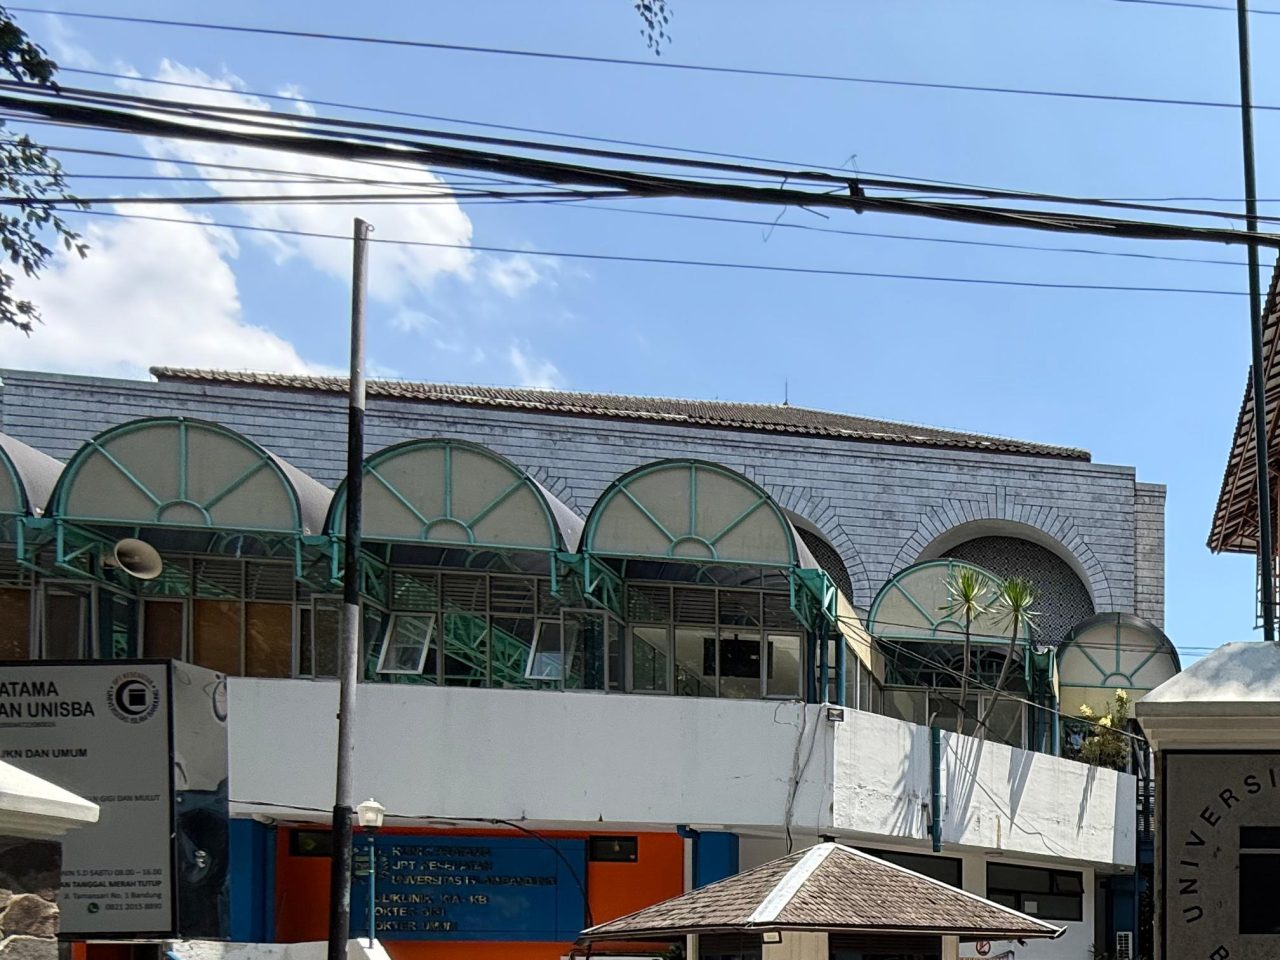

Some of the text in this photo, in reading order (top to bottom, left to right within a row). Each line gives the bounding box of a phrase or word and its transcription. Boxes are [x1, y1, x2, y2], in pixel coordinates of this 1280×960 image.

[27, 701, 95, 718] UNISBA
[25, 749, 50, 758] DAN
[52, 748, 88, 758] UMUM
[72, 880, 107, 889] TANGGAL
[108, 880, 137, 888] MERAH
[138, 880, 162, 888] TUTUP
[131, 891, 162, 901] Bandung
[469, 895, 489, 905] KB
